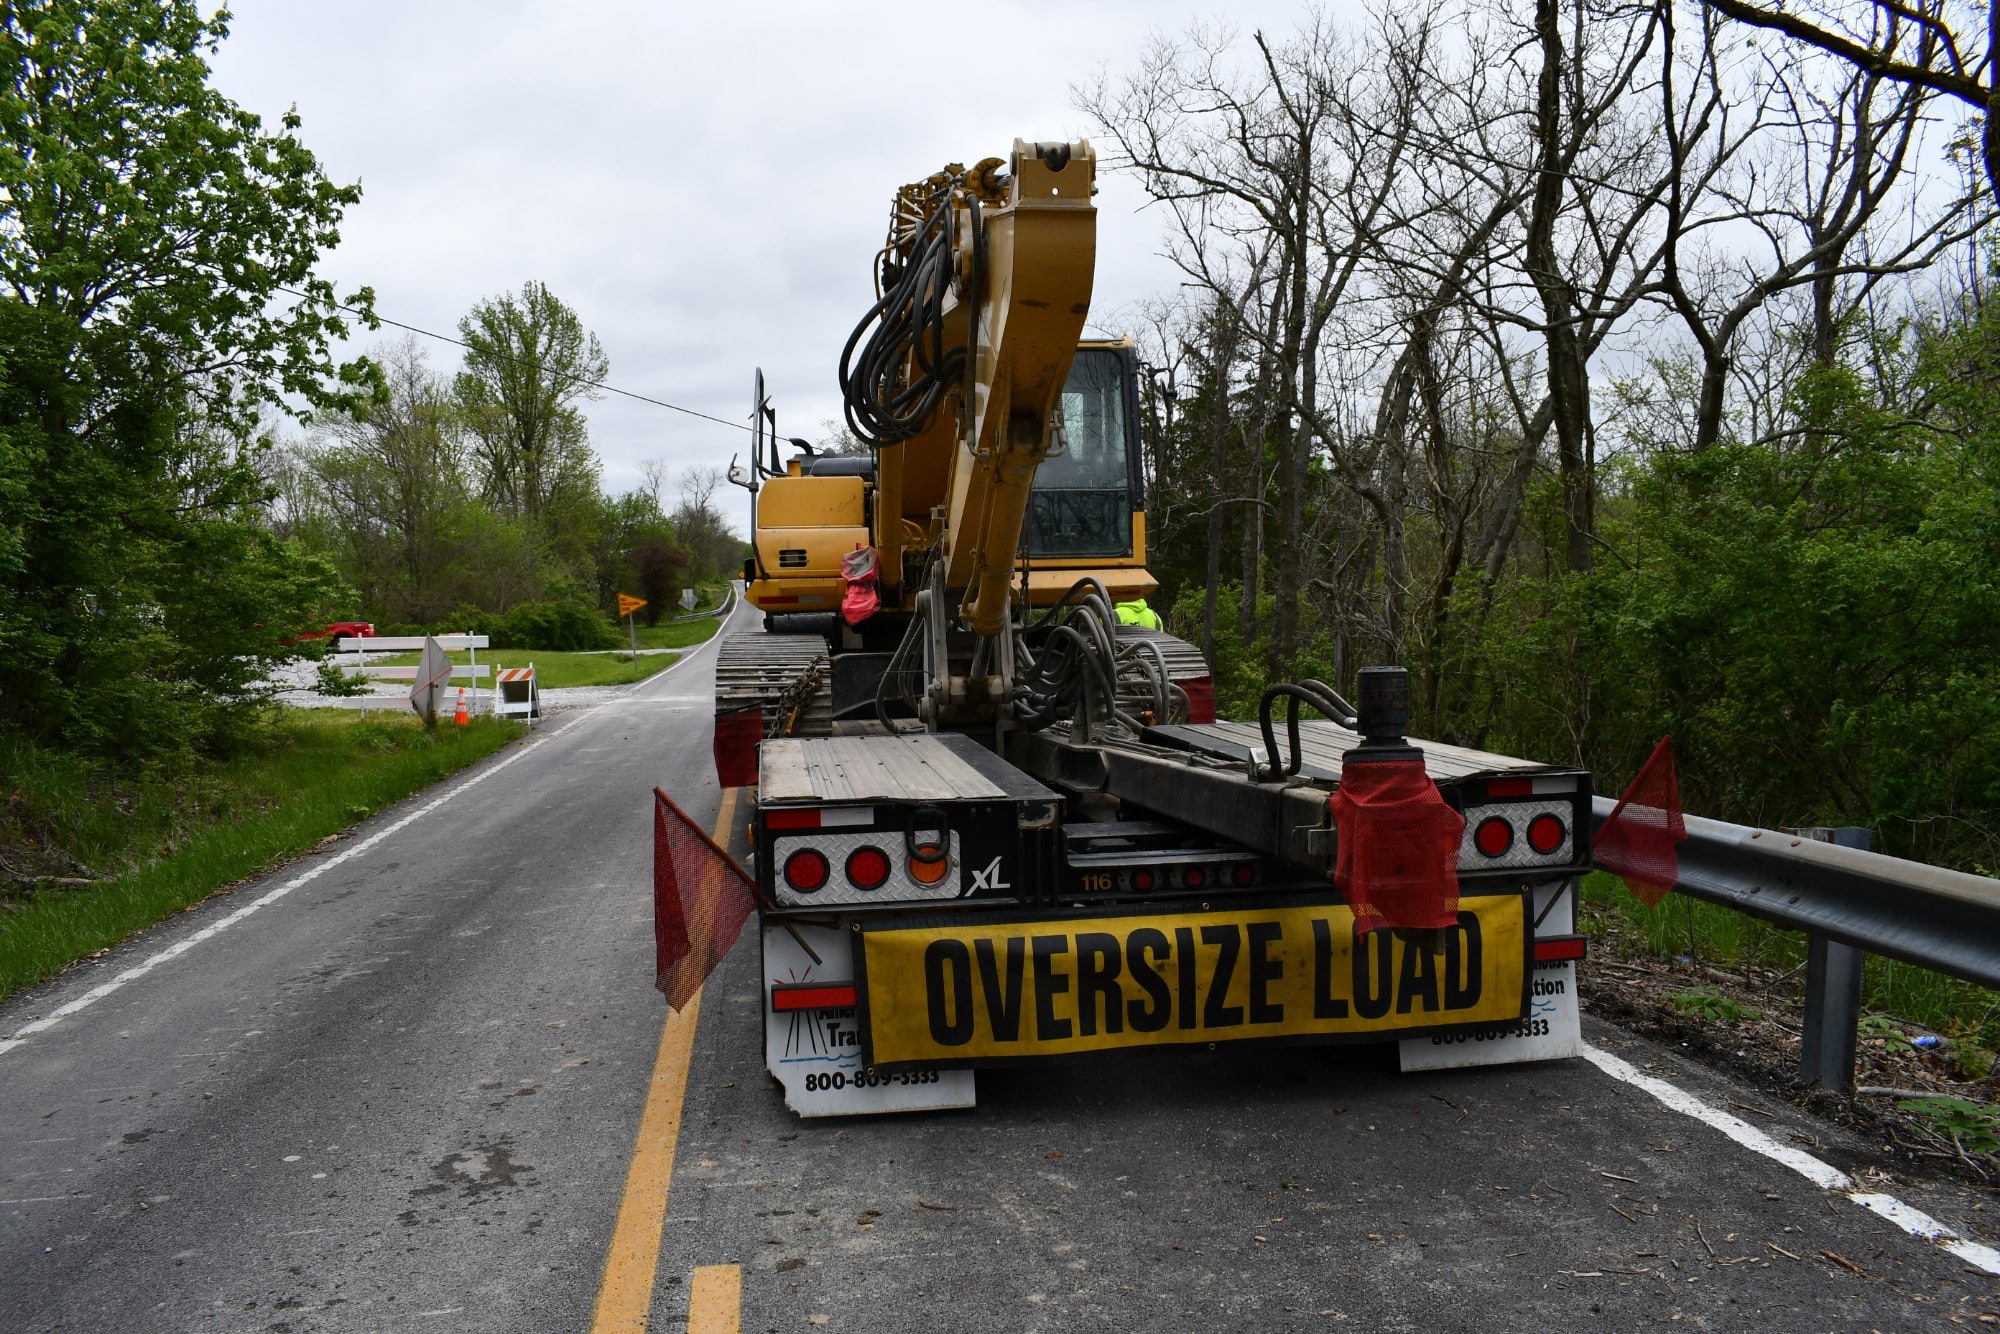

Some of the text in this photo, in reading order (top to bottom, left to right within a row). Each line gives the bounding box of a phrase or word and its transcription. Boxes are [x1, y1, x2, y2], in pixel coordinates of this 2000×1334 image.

[1081, 873, 1112, 891] 116
[924, 910, 1483, 1047] OVERSIZE LOAD
[1531, 977, 1565, 997] tion
